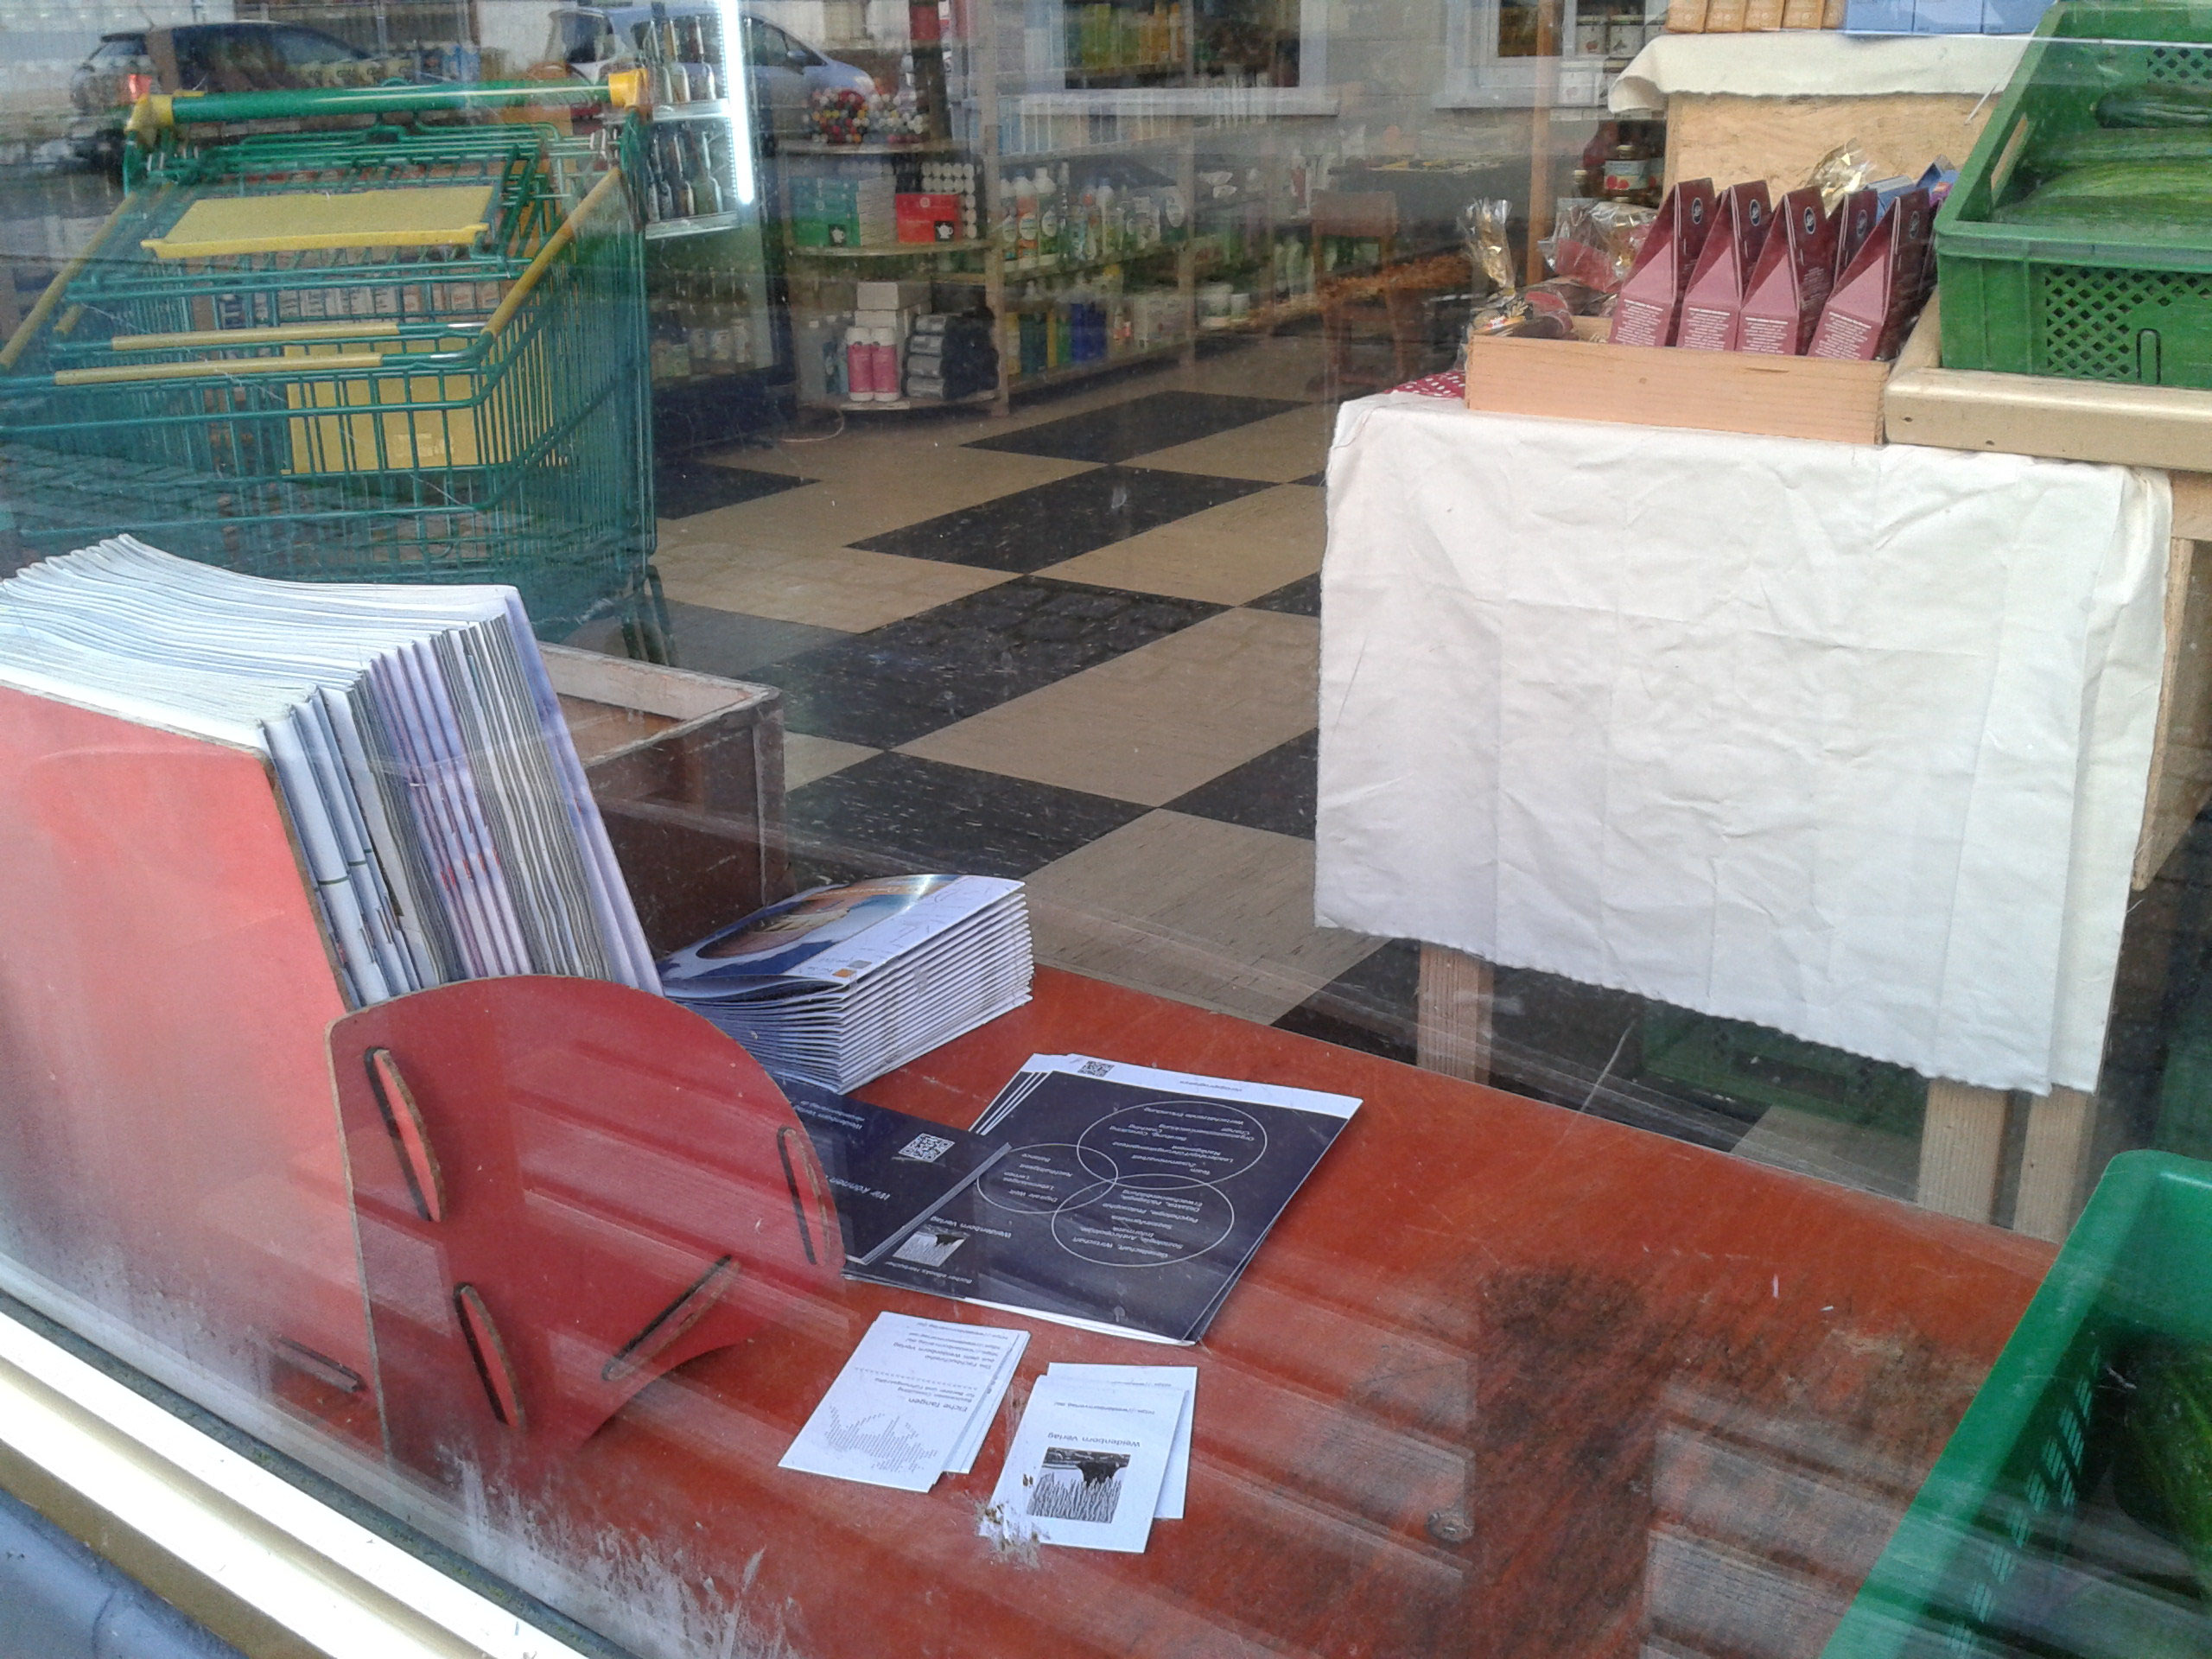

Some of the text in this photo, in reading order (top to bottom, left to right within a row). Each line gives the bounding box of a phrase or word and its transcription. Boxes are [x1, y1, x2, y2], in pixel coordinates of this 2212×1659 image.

[1020, 1153, 1052, 1162] Balance
[829, 1178, 891, 1201] Wir können
[930, 1216, 1012, 1239] Weidenborn Verlag
[1071, 1236, 1114, 1249] Wirtschaft
[1047, 1432, 1141, 1448] Weidenborn Verlag
